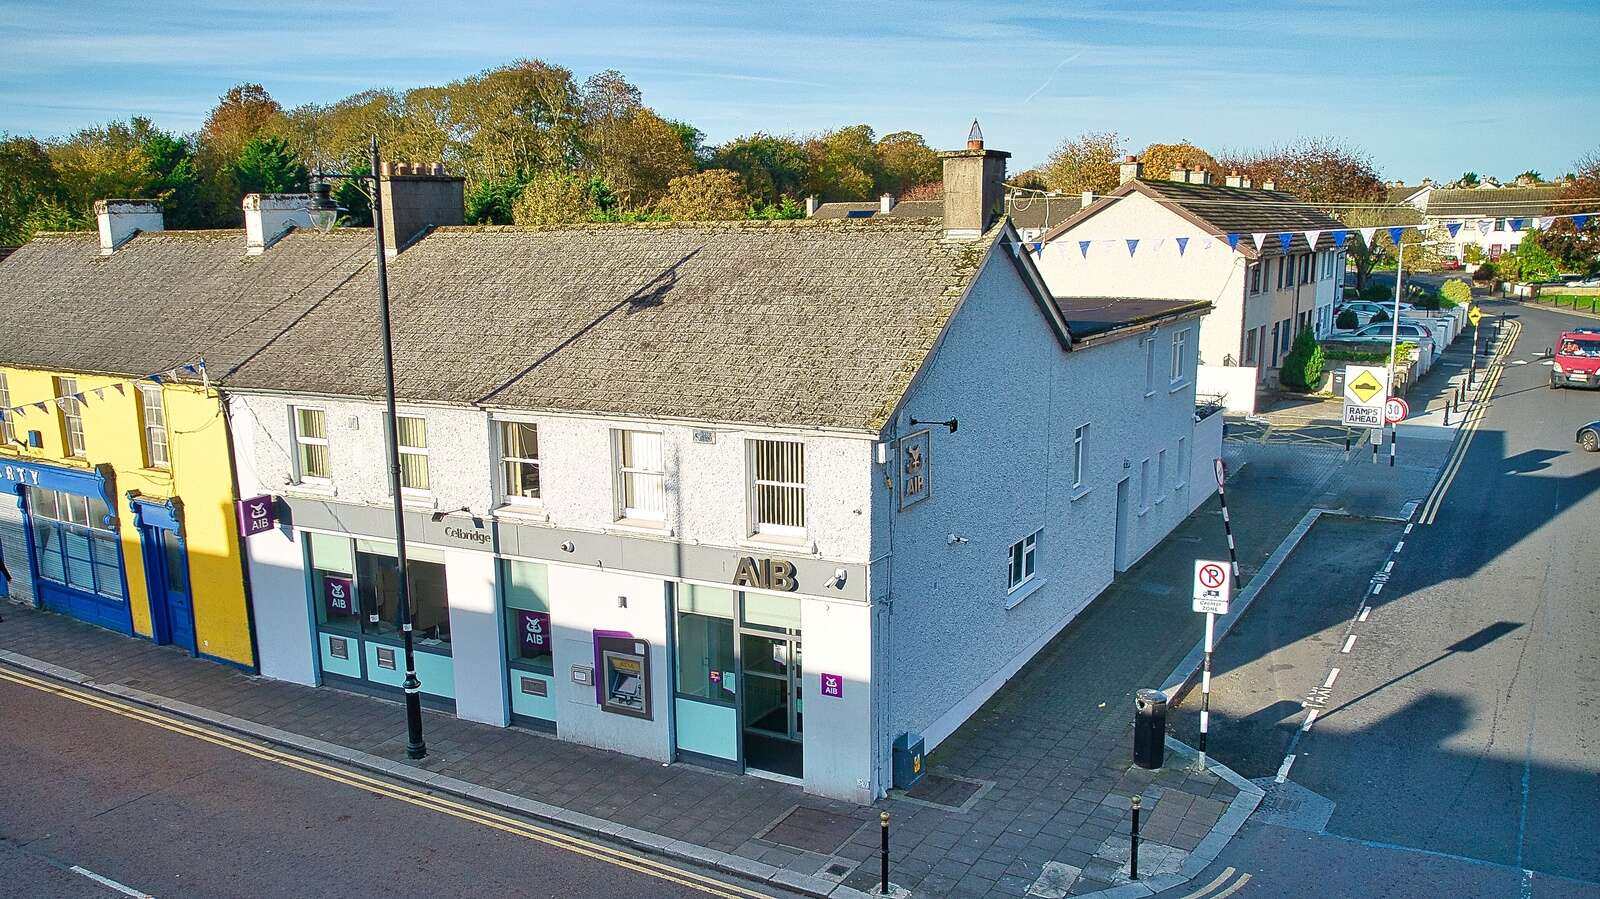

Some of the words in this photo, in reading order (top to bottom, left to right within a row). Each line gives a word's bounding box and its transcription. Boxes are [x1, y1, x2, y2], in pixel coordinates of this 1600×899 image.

[1349, 407, 1378, 416] RAMPS
[1387, 403, 1400, 415] 30
[1349, 415, 1378, 423] AHEAD
[0, 464, 39, 485] RTY
[251, 518, 269, 531] AIB
[444, 526, 491, 544] Celbridge
[733, 556, 798, 592] AIB
[331, 598, 347, 608] AIB
[526, 632, 544, 645] AIB
[825, 687, 838, 695] AIB
